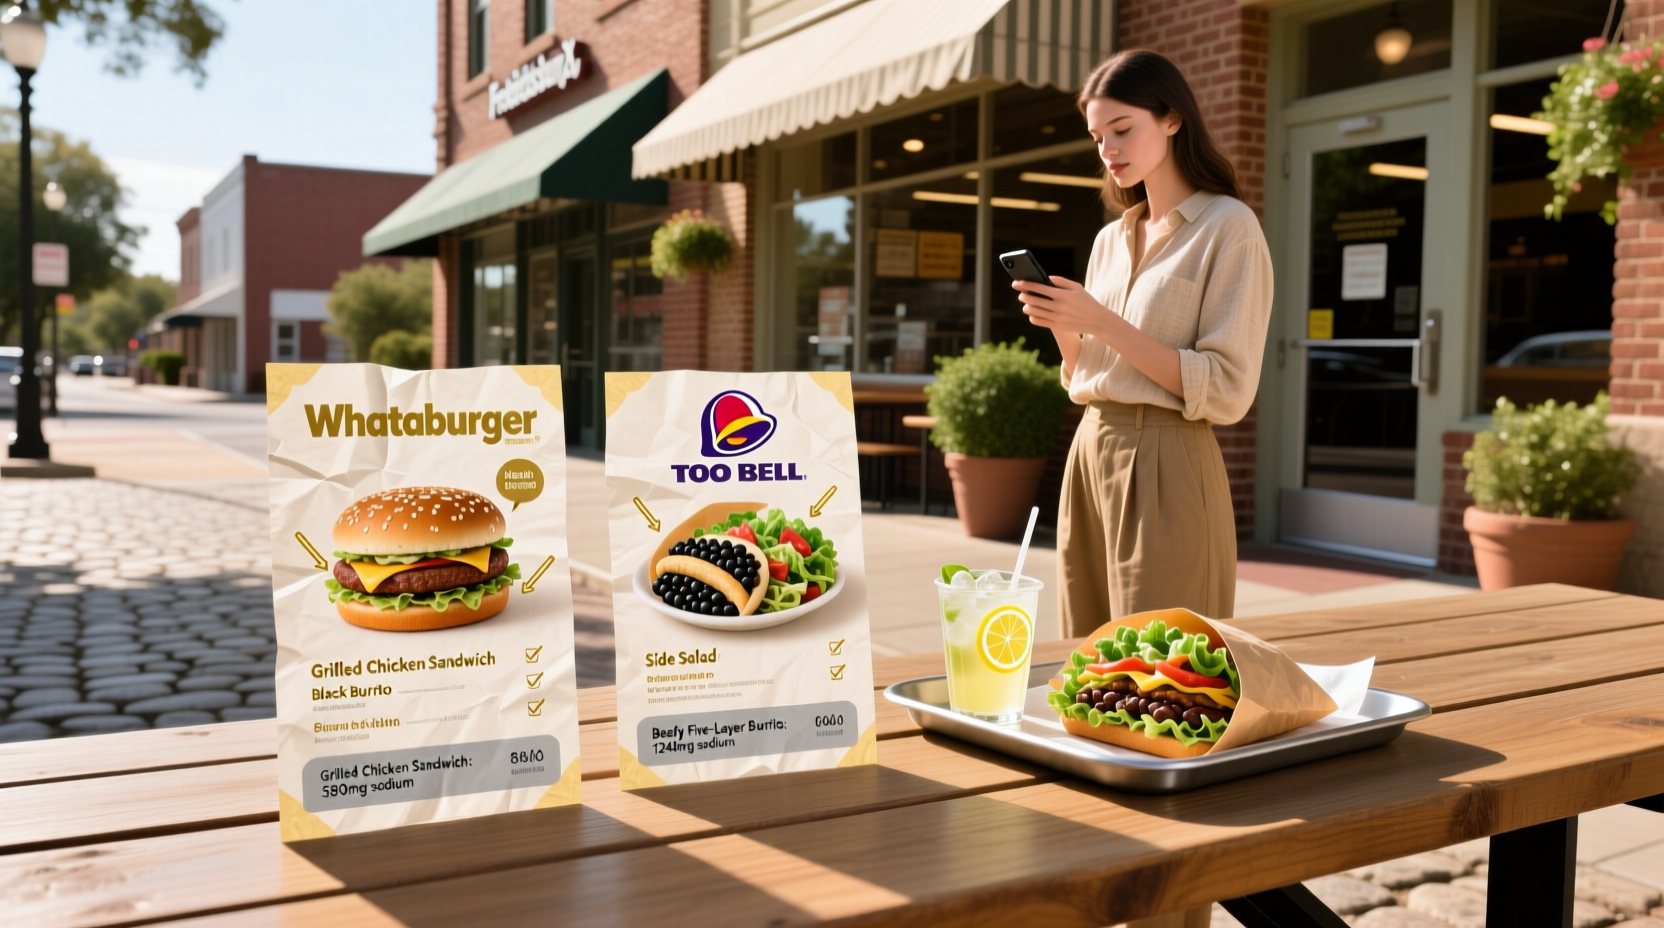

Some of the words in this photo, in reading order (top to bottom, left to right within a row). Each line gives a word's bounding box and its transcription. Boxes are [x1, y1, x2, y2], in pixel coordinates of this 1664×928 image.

[304, 403, 537, 445] Whataburger
[671, 463, 731, 483] TOO
[311, 659, 363, 679] Grilled
[366, 656, 426, 674] Chicken
[428, 651, 496, 670] Sandwich
[645, 651, 676, 668] Side
[678, 647, 717, 665] Salad
[312, 685, 348, 701] Black
[697, 736, 736, 750] sodium
[320, 765, 358, 782] Grilled
[362, 761, 409, 777] Chicken
[411, 754, 473, 773] Sandwich:
[370, 777, 414, 792] sodium
